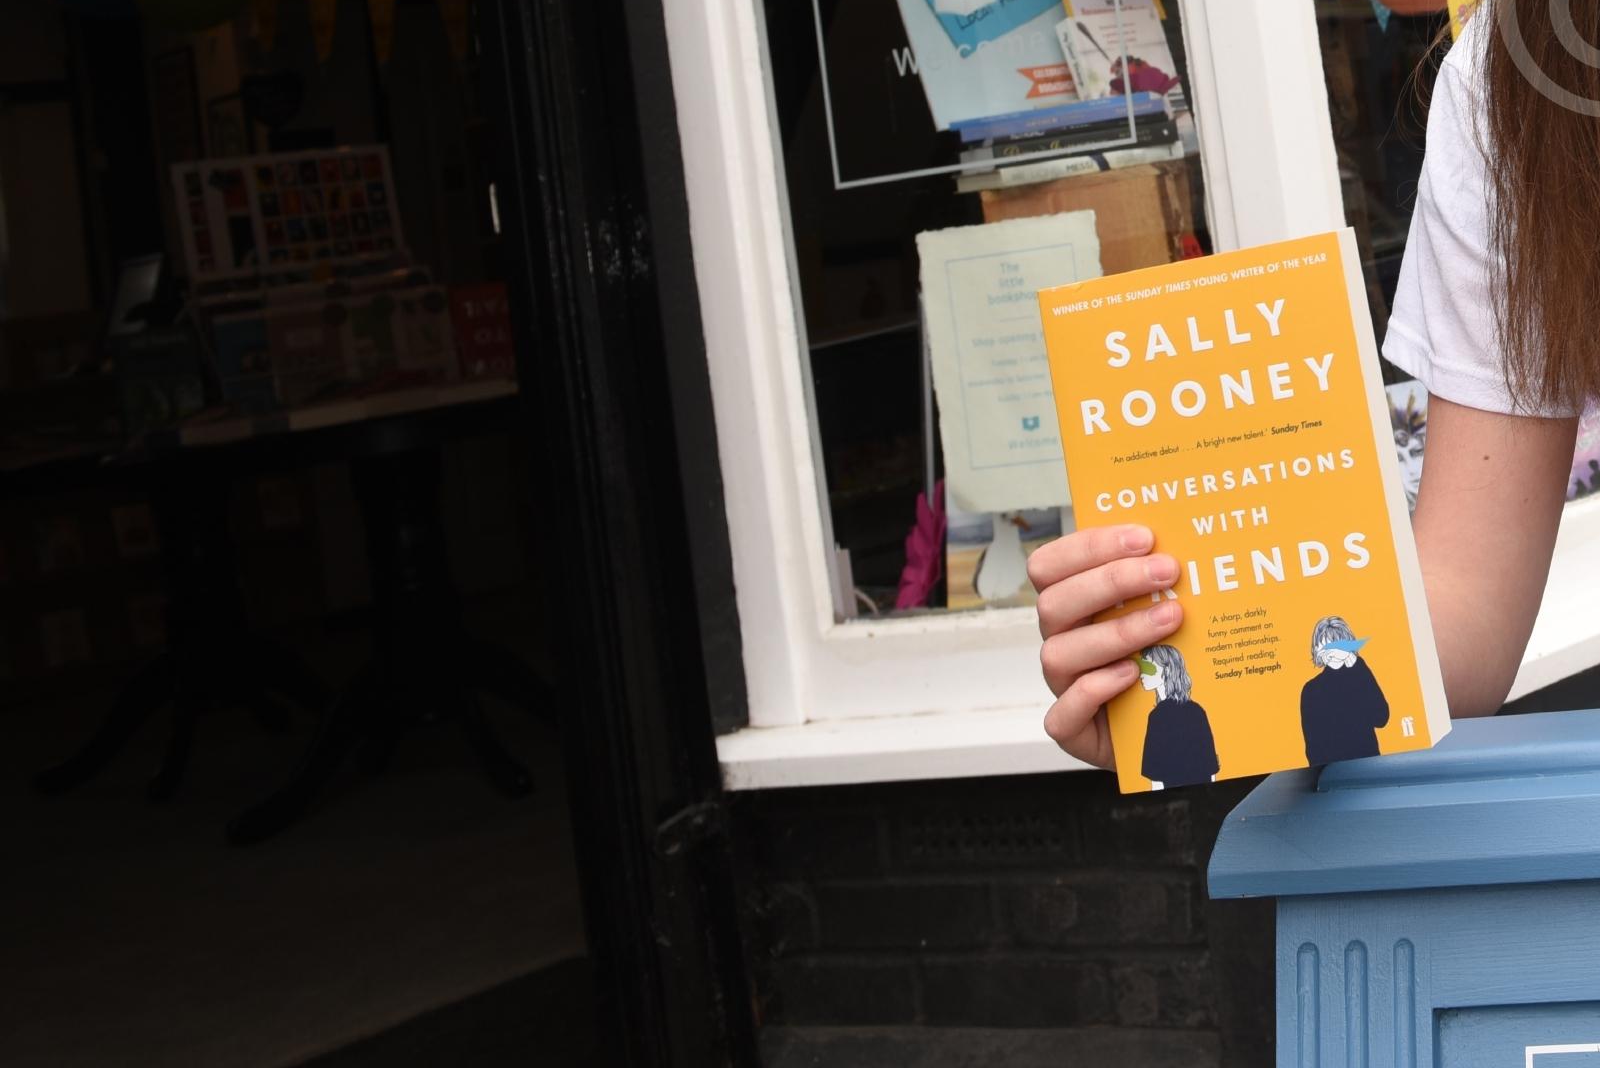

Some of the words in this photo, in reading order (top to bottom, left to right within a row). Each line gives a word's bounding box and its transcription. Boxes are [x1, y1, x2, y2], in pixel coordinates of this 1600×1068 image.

[1053, 301, 1089, 317] WINNER
[1091, 297, 1105, 309] OF
[1107, 294, 1122, 306] THE
[1125, 285, 1162, 302] SUNDAY
[1164, 280, 1191, 294] TIMES
[1193, 272, 1229, 289] YOUNG
[1231, 266, 1265, 282] WRITER
[1267, 262, 1281, 274] OF
[1283, 258, 1300, 271] THE
[1302, 252, 1327, 267] YEAR
[1104, 298, 1287, 369] SALLY
[1079, 352, 1335, 436] ROONEY
[1125, 449, 1158, 463] addictive
[1159, 445, 1180, 457] debut
[1196, 441, 1203, 449] A
[1204, 436, 1226, 449] bright
[1226, 436, 1242, 444] new
[1271, 423, 1299, 436] Sunday
[1300, 420, 1323, 430] Times
[1095, 448, 1356, 513] CONVERSATIONS
[1191, 505, 1269, 536] WITH
[1116, 532, 1371, 609] IENDS
[1244, 606, 1267, 618] darkly
[1205, 642, 1233, 653] modern
[1207, 629, 1228, 639] funny
[1229, 623, 1262, 635] comment
[1212, 653, 1245, 666] Required
[1215, 668, 1243, 680] Sunday
[1244, 660, 1282, 676] Telegraph
